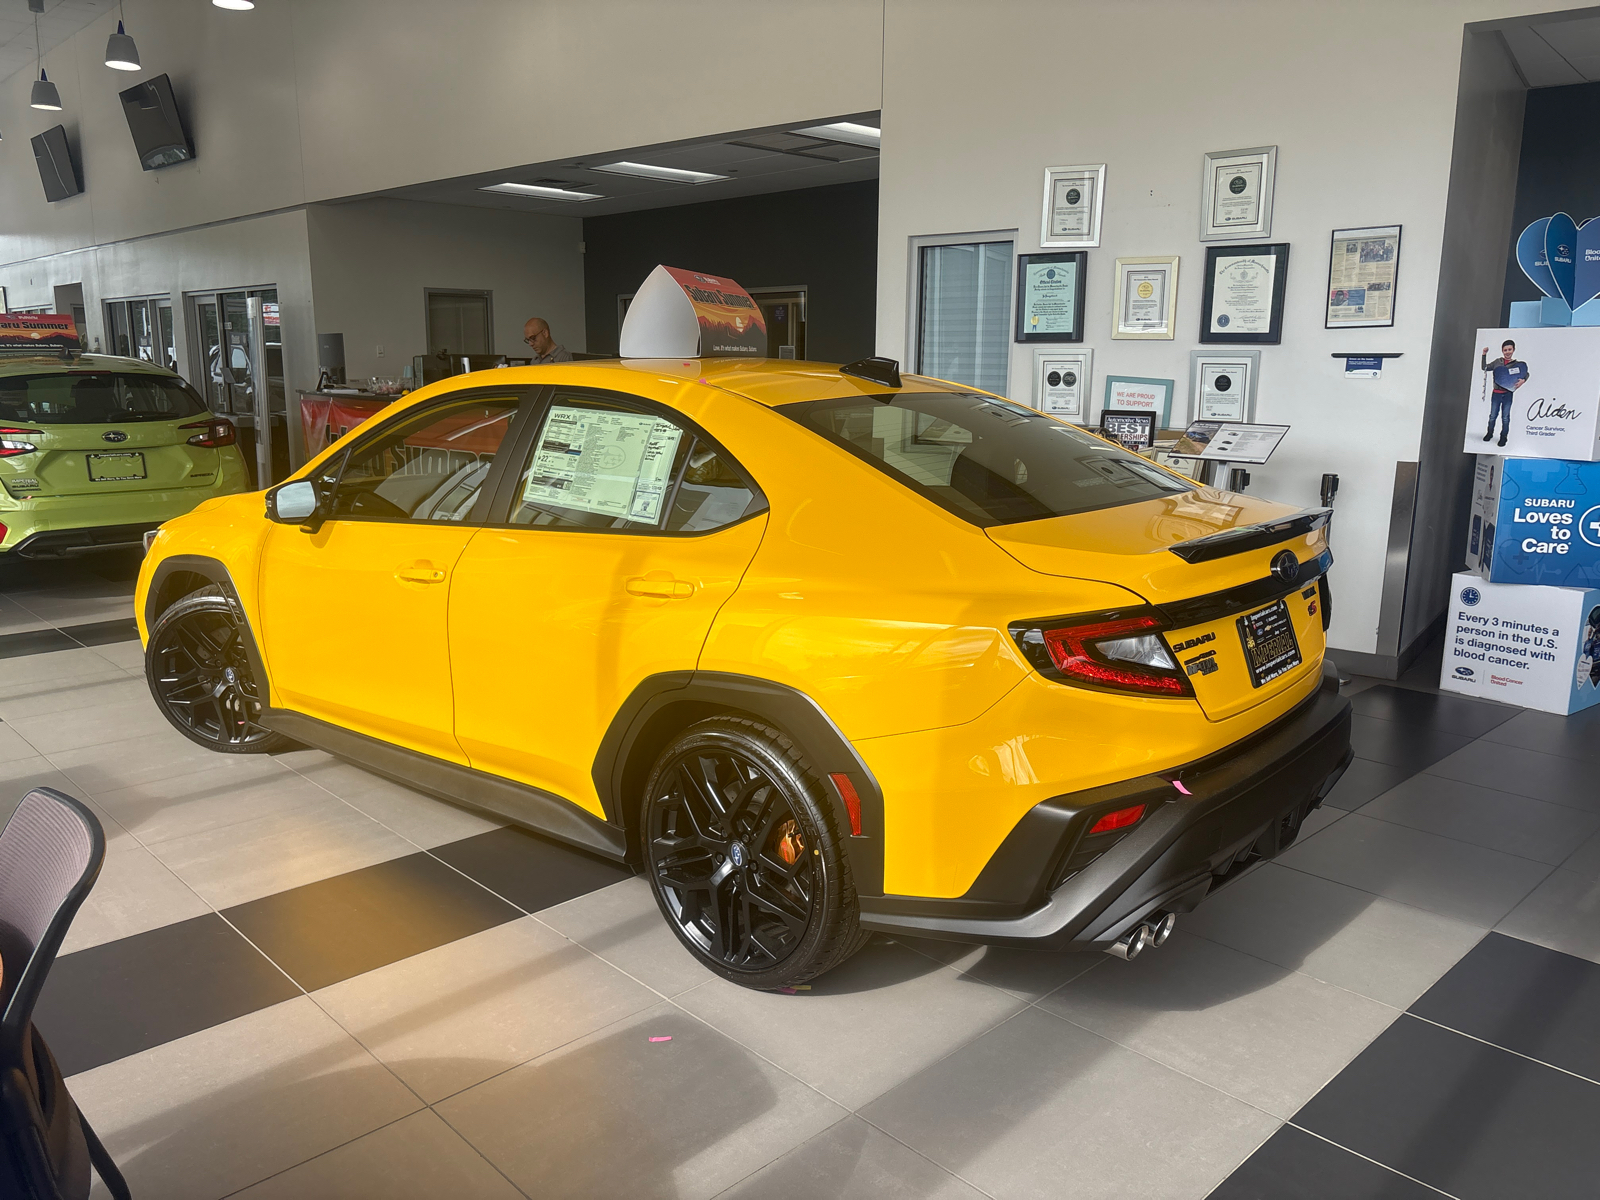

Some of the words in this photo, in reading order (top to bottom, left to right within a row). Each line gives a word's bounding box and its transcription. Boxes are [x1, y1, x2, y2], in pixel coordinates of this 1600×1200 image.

[683, 284, 724, 306] Subaru
[715, 288, 756, 310] Summer
[21, 322, 68, 330] Summer
[1527, 398, 1582, 421] Aiden
[1106, 424, 1148, 434] BEST
[1524, 498, 1575, 508] SUBARU
[1514, 508, 1573, 525] Loves
[1551, 526, 1571, 540] to
[1522, 538, 1569, 554] Care
[1458, 612, 1489, 626] Every
[1492, 617, 1499, 626] 3
[1502, 620, 1549, 634] minutes
[1173, 632, 1216, 653] SUBARU
[1456, 626, 1495, 638] person
[1498, 631, 1508, 640] in
[1512, 633, 1530, 644] the
[1534, 637, 1558, 649] U.S.
[1455, 636, 1464, 645] is
[1467, 638, 1527, 656] diagnosed
[1530, 650, 1555, 662] with
[1454, 648, 1485, 661] blood
[1488, 656, 1530, 670] cancer.
[1452, 674, 1476, 683] SUBARU
